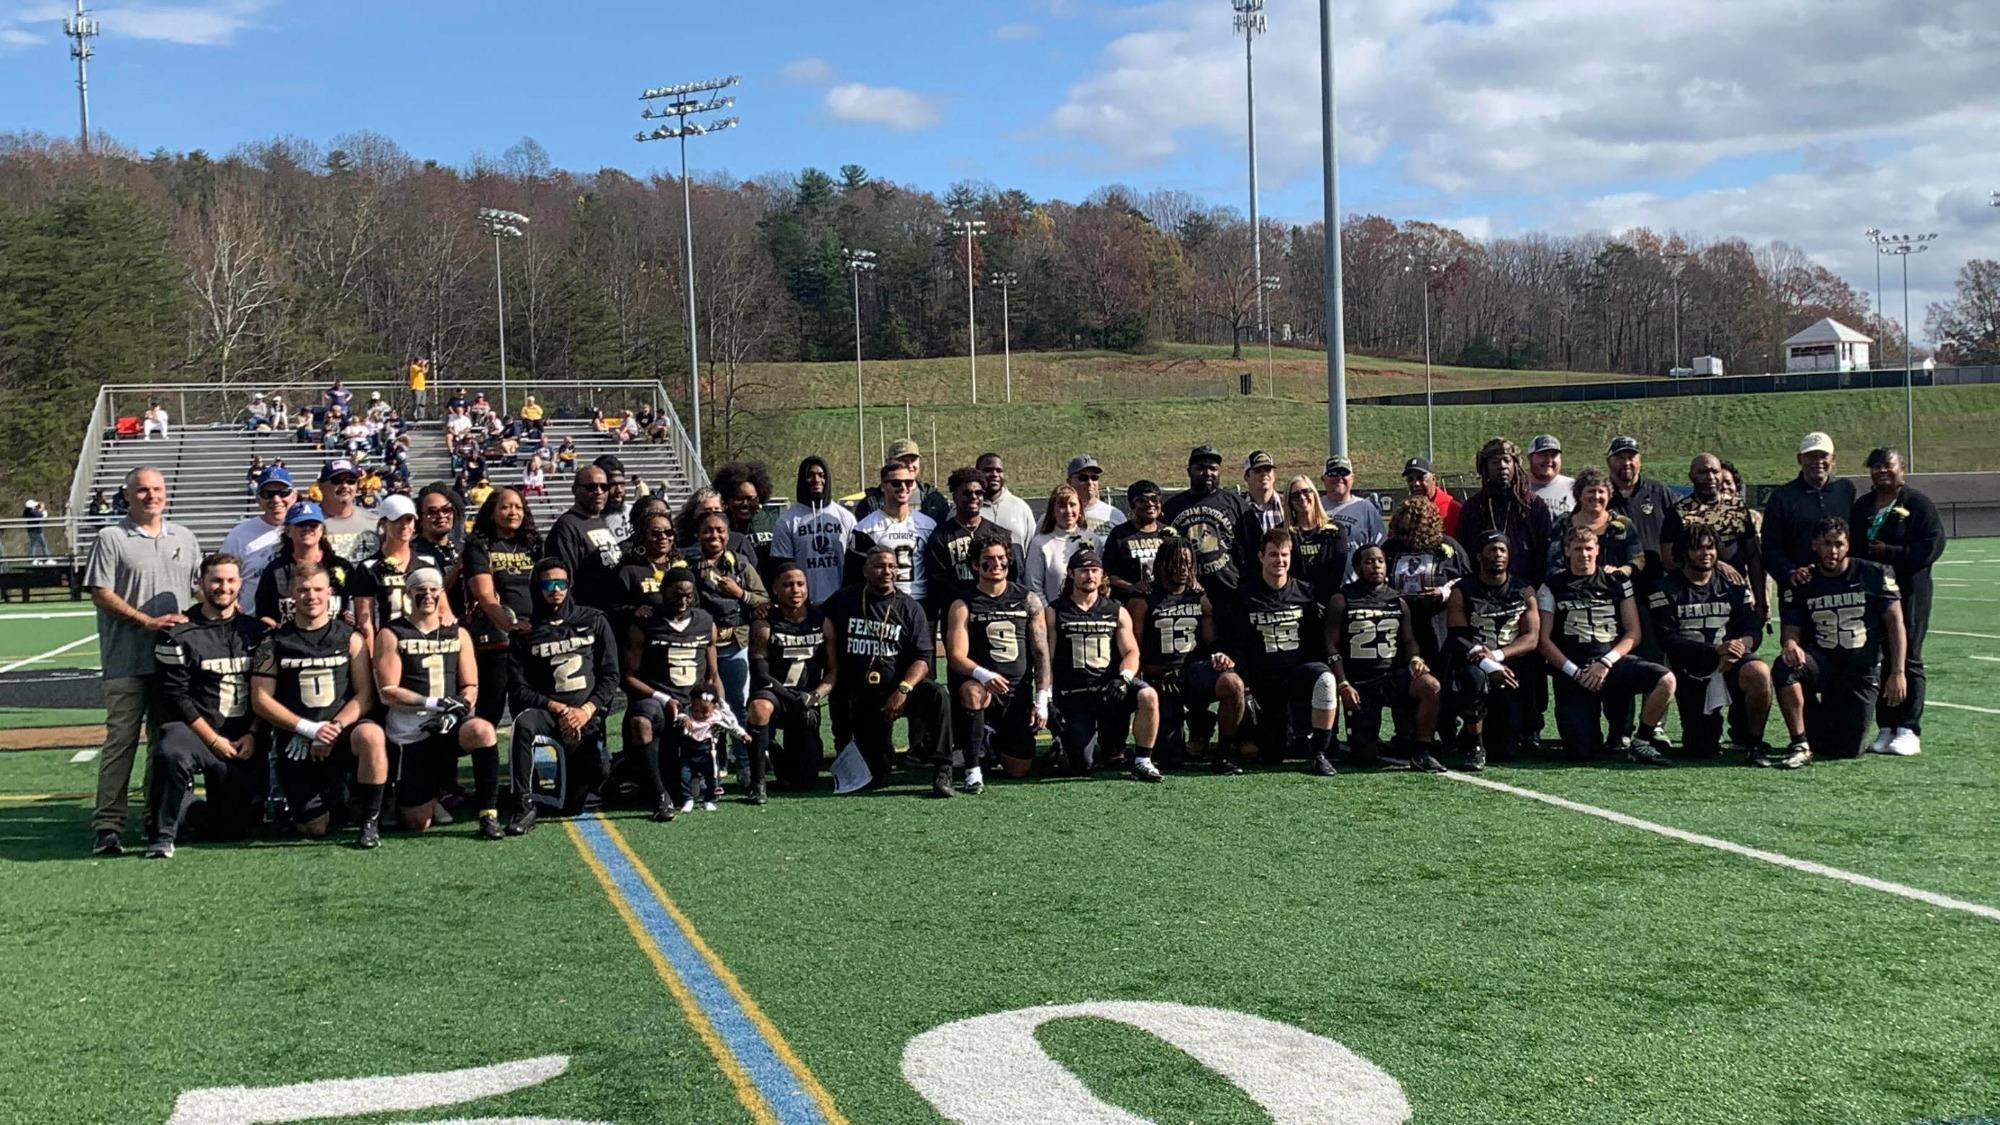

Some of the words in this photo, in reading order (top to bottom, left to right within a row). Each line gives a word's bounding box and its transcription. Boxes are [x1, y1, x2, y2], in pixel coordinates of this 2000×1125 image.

[798, 522, 842, 536] BLACK
[806, 556, 839, 569] HATS
[1131, 549, 1158, 558] FOOT
[846, 637, 899, 657] FOOTBALL
[847, 617, 902, 641] FERRUM
[985, 620, 1019, 663] 9
[1154, 618, 1198, 654] 13
[1348, 618, 1400, 659] 23
[667, 648, 699, 687] 5
[782, 646, 814, 687] 7
[1065, 633, 1112, 668] 10
[299, 668, 336, 708] 0
[421, 654, 445, 700] 1
[550, 653, 587, 693] 2
